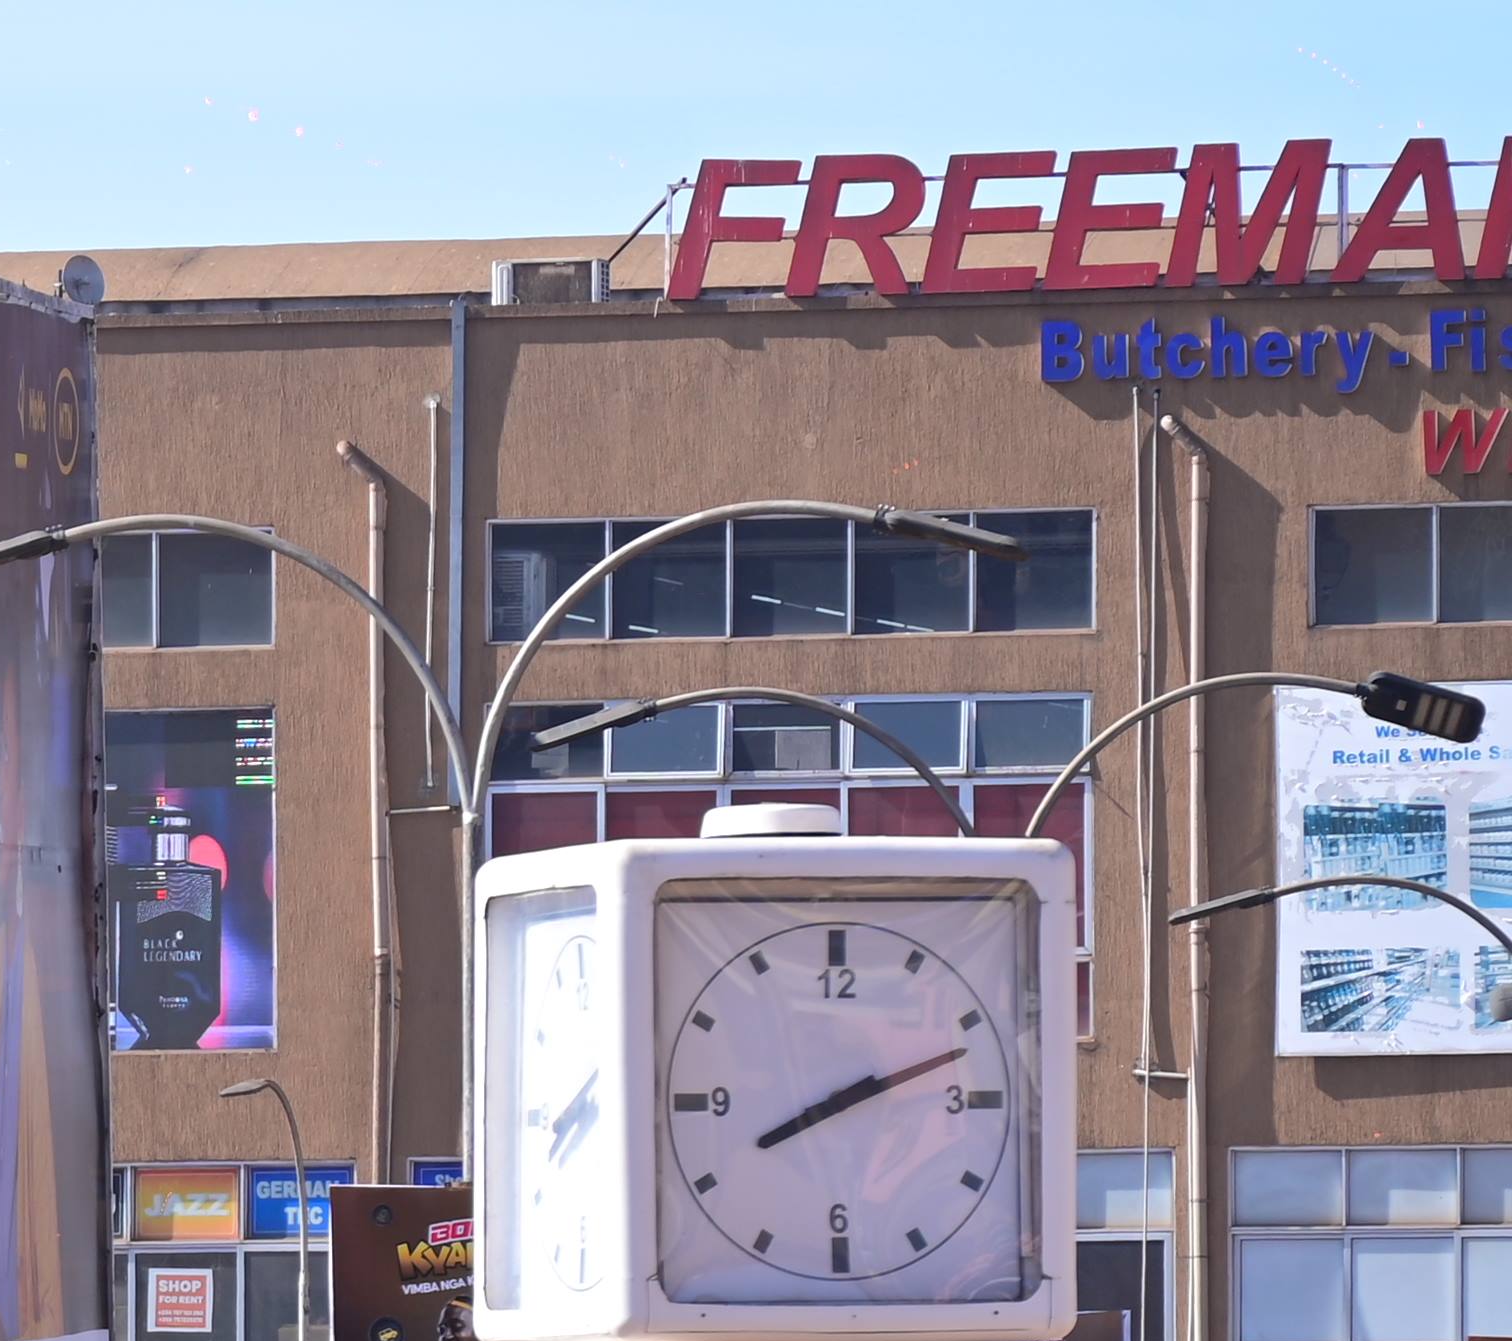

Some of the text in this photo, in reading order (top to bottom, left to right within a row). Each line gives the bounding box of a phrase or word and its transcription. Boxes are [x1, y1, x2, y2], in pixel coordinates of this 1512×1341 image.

[1041, 316, 1374, 394] Butchery
[1332, 746, 1482, 765] Retail Whole
[144, 950, 203, 962] LEGENDARY
[817, 970, 856, 1000] 12
[711, 1087, 730, 1115] 9
[945, 1087, 963, 1114] 3
[144, 1193, 231, 1217] JAZZ
[829, 1204, 848, 1233] 6
[159, 1280, 202, 1292] SHOP
